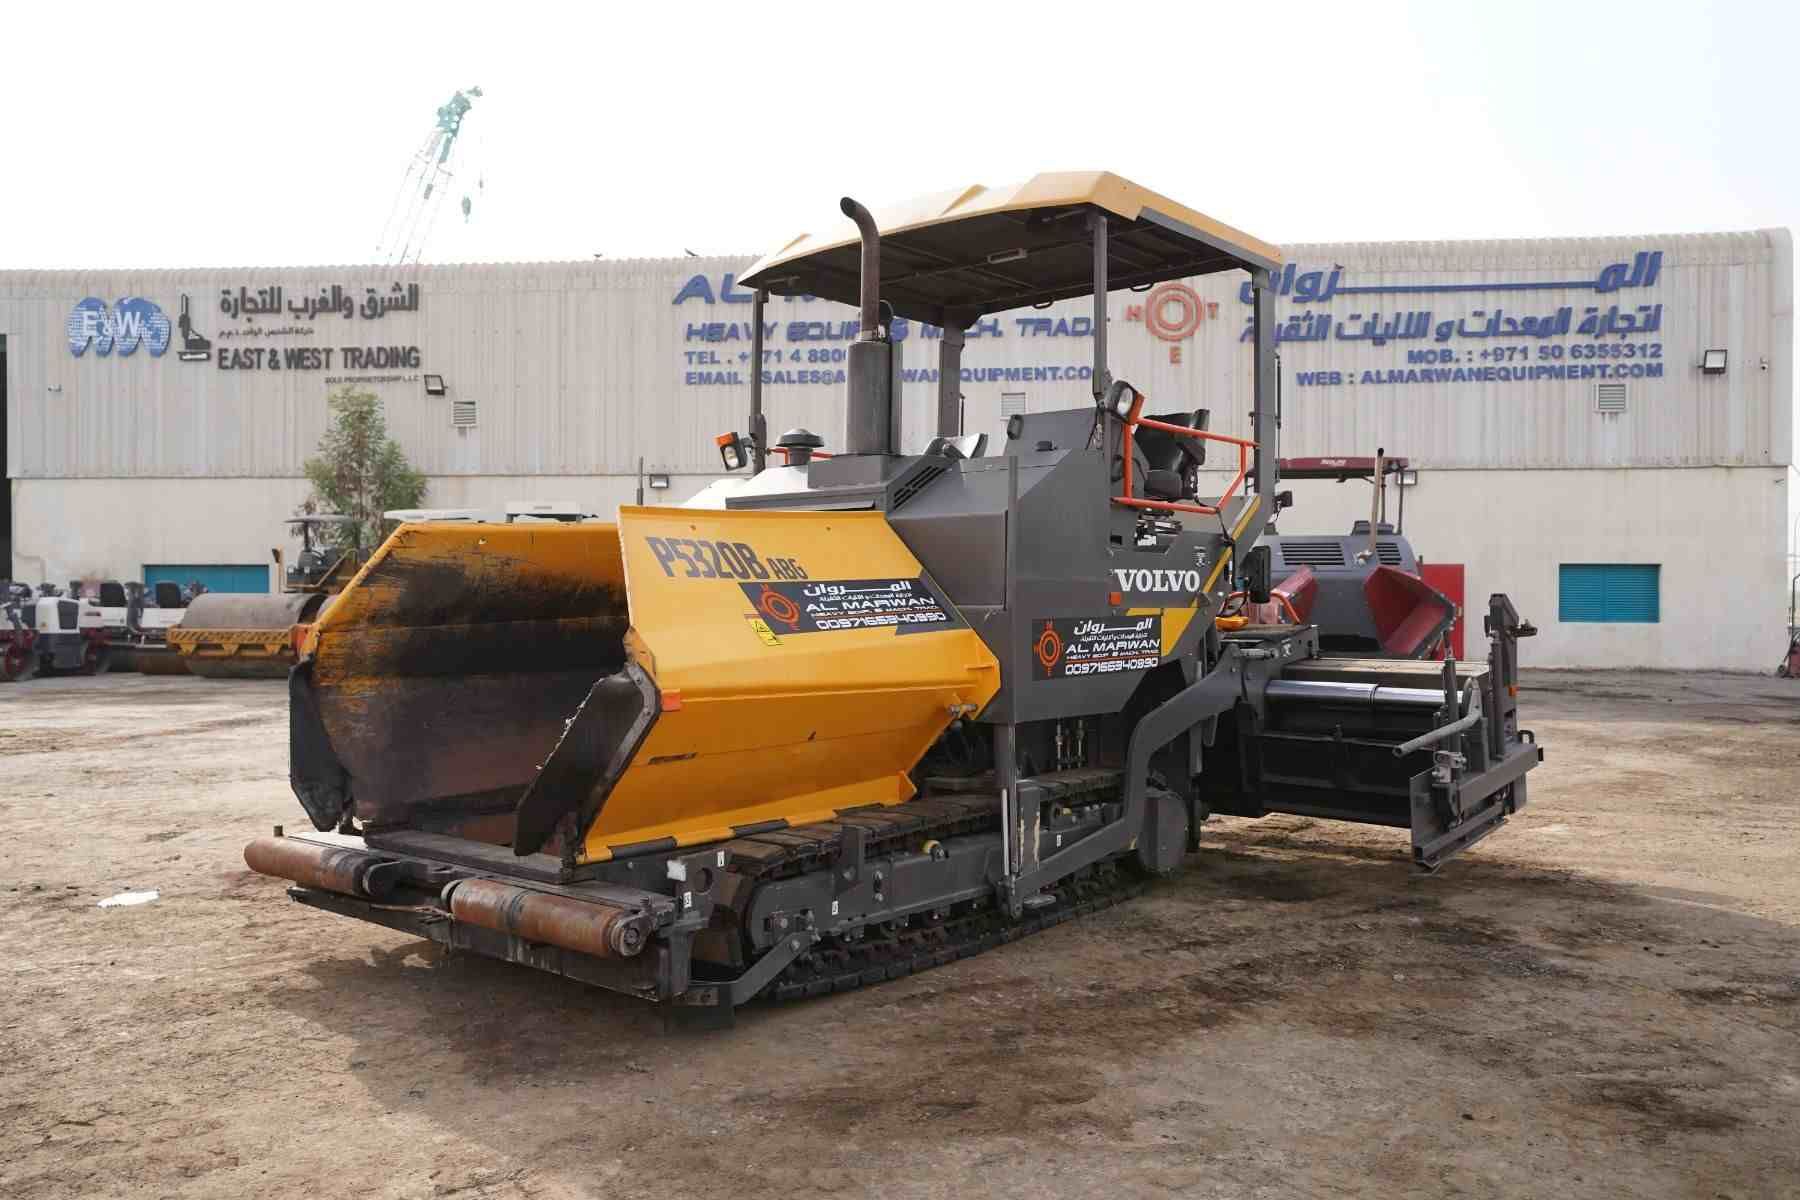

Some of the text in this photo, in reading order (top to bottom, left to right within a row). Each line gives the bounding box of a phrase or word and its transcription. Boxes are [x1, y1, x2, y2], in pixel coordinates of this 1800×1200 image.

[220, 282, 419, 323] الشرق والغرب للتجارة
[217, 346, 420, 371] EAST & WEST TRADING
[684, 351, 721, 365] TEL
[738, 349, 783, 364] +71
[790, 349, 804, 364] 4
[1480, 346, 1529, 362] +971
[1537, 346, 1565, 360] 50
[1570, 343, 1663, 360] 6355312
[686, 371, 743, 385] EMAIL
[1296, 371, 1342, 386] WEB
[1360, 362, 1663, 385] ALMARWANEQUIPMENT.COM
[645, 536, 770, 579] P5320B
[1114, 568, 1200, 592] VOLVO
[806, 603, 838, 612] AL
[843, 597, 936, 611] MARWAN
[1065, 639, 1161, 654] AL MARWAN
